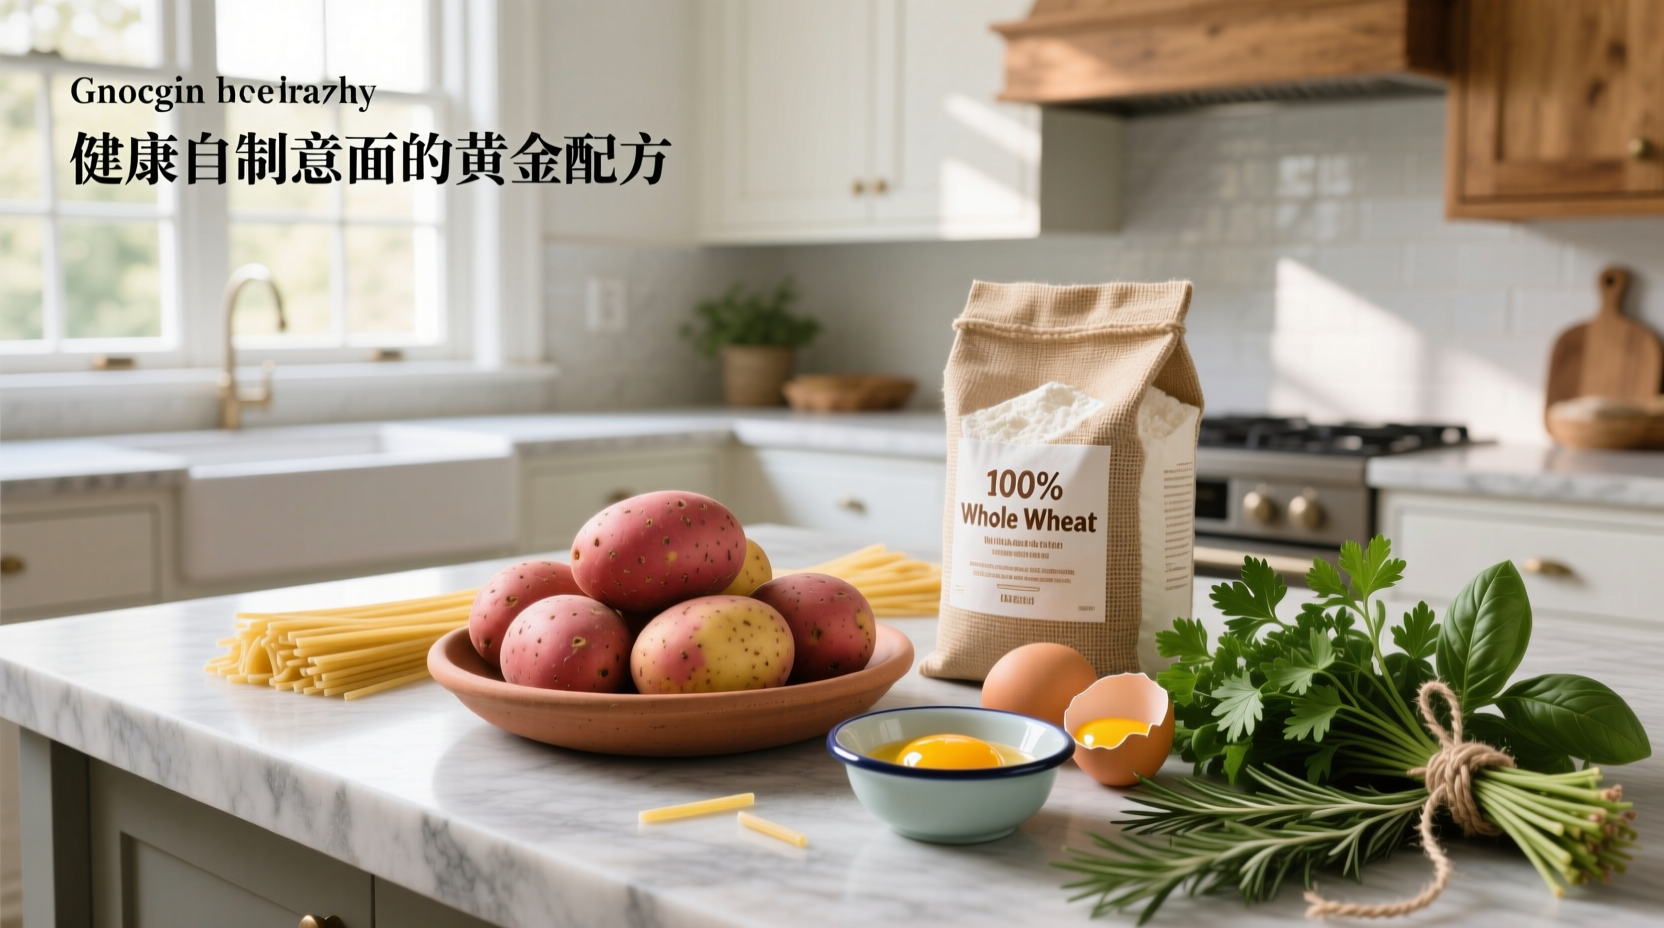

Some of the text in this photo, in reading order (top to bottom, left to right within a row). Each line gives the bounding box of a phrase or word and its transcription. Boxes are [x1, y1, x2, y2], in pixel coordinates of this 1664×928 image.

[987, 469, 1063, 501] 100%
[961, 502, 1098, 533] Whole Wheat
